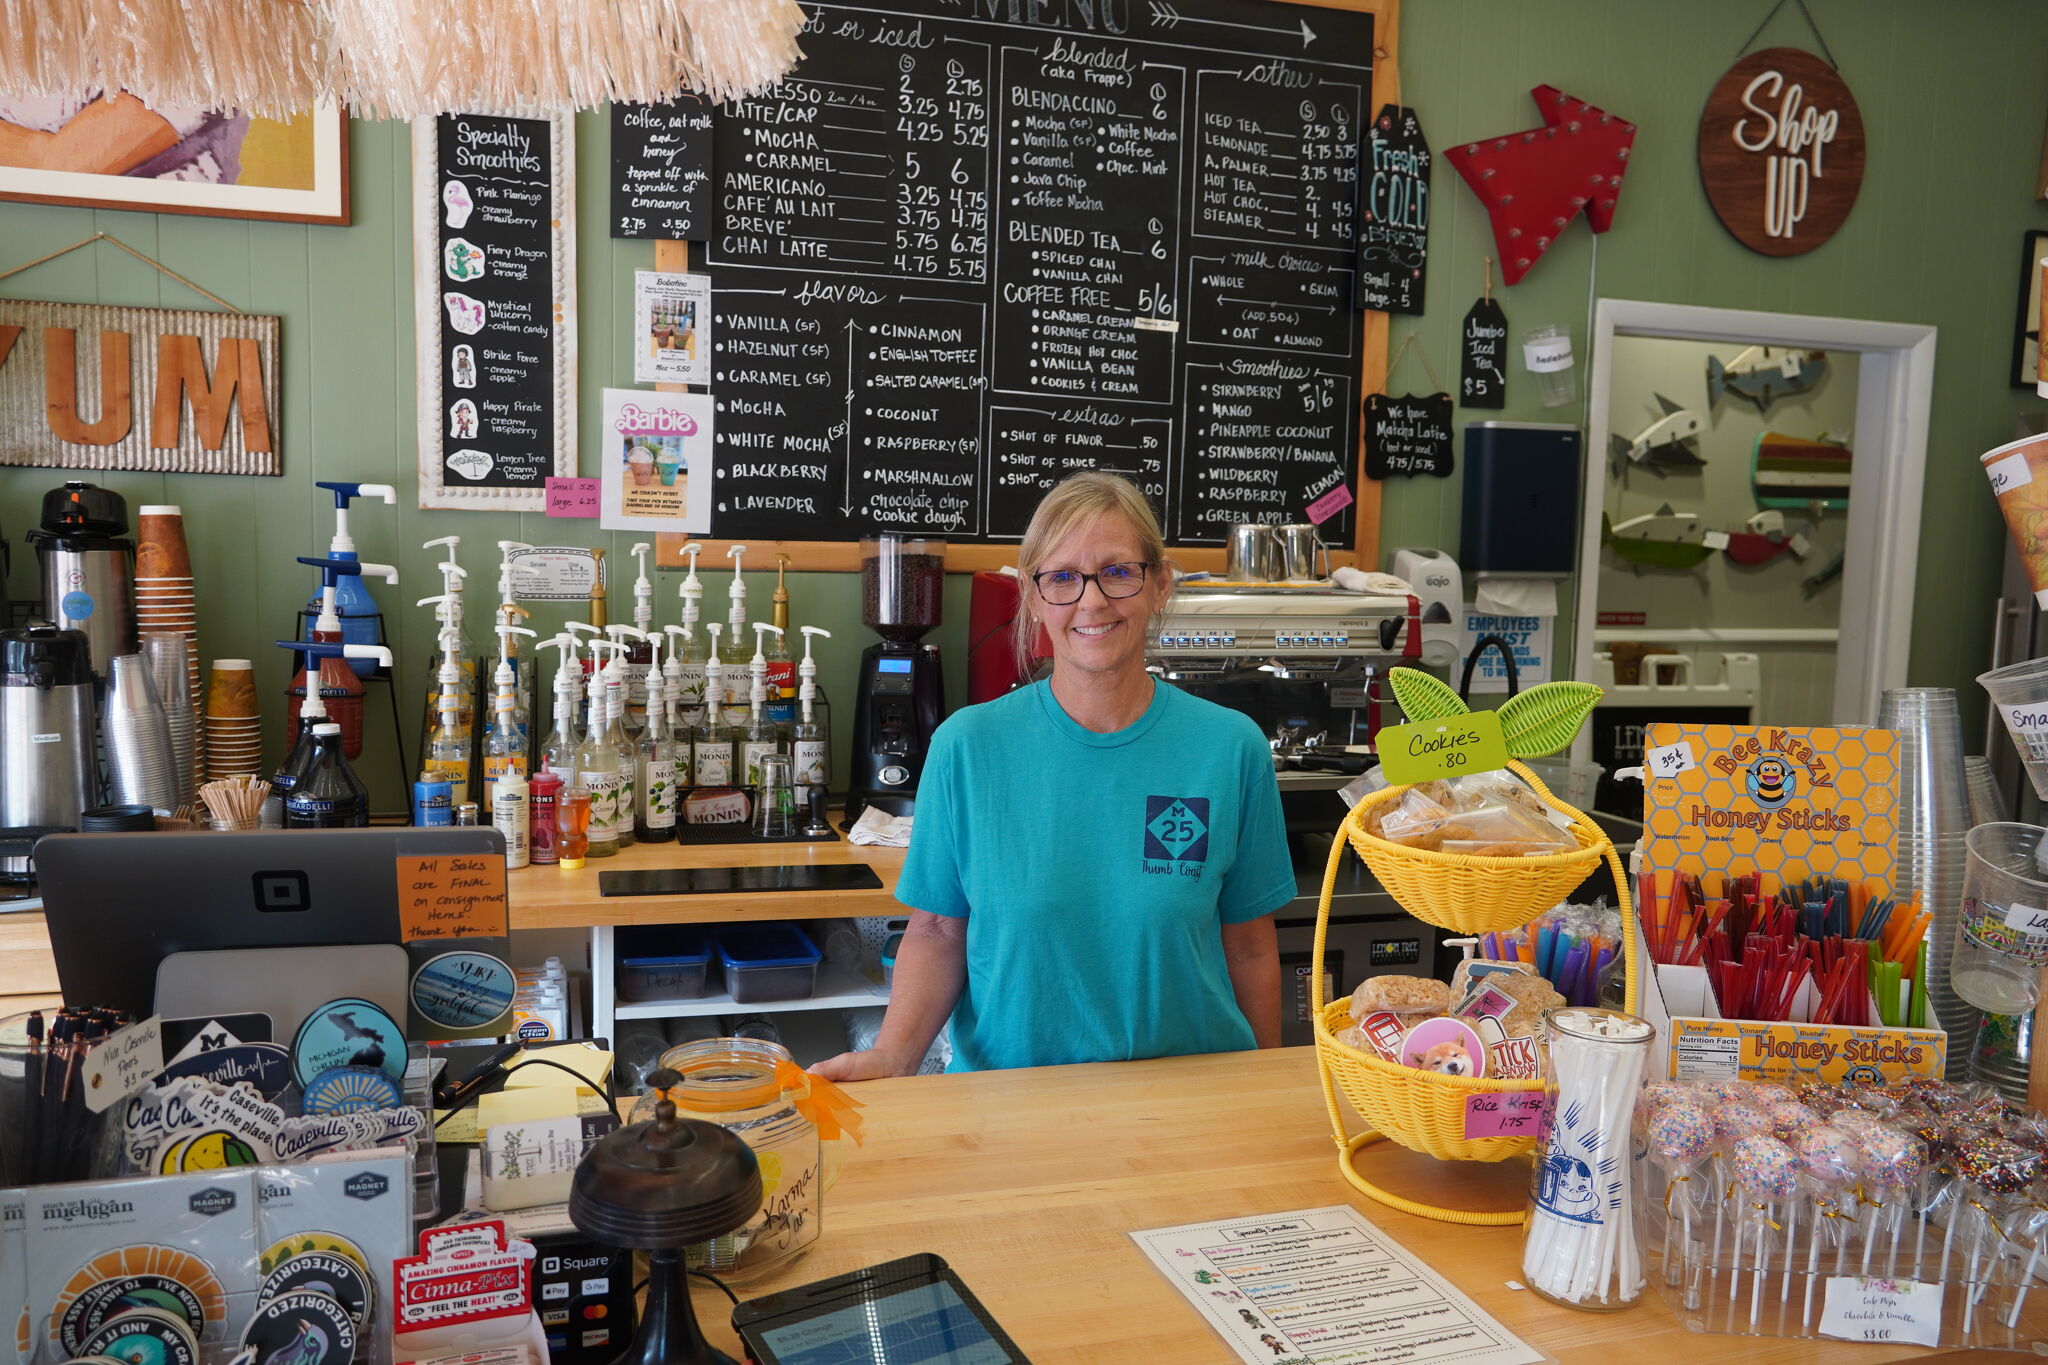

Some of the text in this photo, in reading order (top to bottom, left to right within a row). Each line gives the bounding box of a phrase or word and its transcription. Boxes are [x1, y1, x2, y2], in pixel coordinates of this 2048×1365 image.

[1043, 37, 1136, 72] blended
[947, 79, 983, 97] 2.75
[1012, 86, 1116, 115] BLENDACCINO
[1732, 70, 1839, 178] Shop
[457, 122, 530, 157] Specialty
[755, 130, 819, 150] MOCHA
[457, 147, 541, 173] Smoothies
[1372, 138, 1418, 176] Fresh
[724, 172, 987, 211] AMERICANO 3.25 4.75
[1204, 173, 1256, 193] HOT TEA
[476, 187, 542, 206] Pink Flamingo
[1370, 172, 1429, 228] COLD
[621, 217, 691, 230] 2.75 3.50
[1204, 208, 1264, 229] STEAMER
[896, 230, 987, 253] 5.75 6.75
[1009, 220, 1120, 251] BLENDED TEA
[1368, 226, 1426, 250] BREW
[515, 247, 547, 262] Dragon
[722, 235, 985, 278] CHAI LATTE 4.75 5.75
[1041, 251, 1116, 270] SPICED CHAI
[1209, 275, 1245, 288] WHOLE
[793, 280, 887, 305] flavors
[1004, 283, 1110, 308] COFFEE FREE
[488, 300, 532, 313] Mystical
[727, 314, 789, 333] VANILLA
[1233, 327, 1259, 339] OAT
[1466, 318, 1505, 339] Jumbo
[881, 324, 962, 343] CINNAMON
[483, 350, 539, 364] Strike Force
[728, 339, 798, 358] HAZELNUT
[880, 346, 978, 364] ENGLISH TOFFEE
[1470, 341, 1496, 356] Iced
[729, 369, 801, 387] CARAMEL
[875, 374, 916, 388] SALTED
[483, 400, 542, 415] Happy Pirate
[731, 398, 787, 417] MOCHA
[1387, 404, 1428, 420] We have
[616, 403, 698, 436] Barbie
[1210, 423, 1334, 439] PINEAPPLE COCONUT
[1377, 421, 1447, 440] Matcha Latte
[728, 432, 831, 453] WHITE MOCHA
[496, 453, 546, 464] Lemon Tree
[732, 463, 827, 482] BLACKBERRY
[874, 468, 974, 487] MARSHMALLOW
[1209, 468, 1278, 486] WILDBERRY
[735, 495, 816, 514] LAVENDER
[1209, 487, 1287, 506] RASPBERRY
[1206, 509, 1249, 523] GREEN
[1468, 616, 1539, 631] EMPLOYEES
[1409, 728, 1481, 758] Cookies
[700, 752, 731, 761] MONIN
[1712, 729, 1833, 789] Bee Krazy
[694, 809, 742, 824] MONIN
[1171, 806, 1185, 817] M
[1691, 805, 1851, 834] Honey Sticks
[1161, 820, 1194, 842] 25
[1655, 833, 1690, 841] Watermelon
[1762, 837, 1782, 845] Cherry
[450, 859, 486, 871] Sales
[1141, 860, 1173, 875] Thumb
[1686, 1024, 1723, 1034] Pure Honey
[1739, 1027, 1772, 1035] Cinnamon
[1799, 1030, 1831, 1039] Blueberry
[1856, 1032, 1892, 1041] Strawberry
[200, 1033, 227, 1051] M
[1680, 1036, 1739, 1046] Nutrition Facts
[1903, 1034, 1944, 1044] Green Apple
[1755, 1035, 1923, 1066] Honey Sticks
[1471, 1098, 1498, 1113] Rice
[220, 1108, 242, 1128] the
[275, 1119, 347, 1158] Caseville
[348, 1182, 386, 1192] MAGNET
[191, 1198, 233, 1208] MAGNET
[763, 1162, 818, 1232] Karma
[42, 1200, 134, 1220] michigan
[407, 1256, 518, 1280] AMAZING CINNAMON FLAVOR
[563, 1256, 609, 1270] Square
[410, 1271, 516, 1301] Cinna-Pix
[552, 1287, 566, 1296] Pay
[452, 1299, 468, 1309] THE
[548, 1312, 567, 1320] VISA
[120, 1322, 149, 1334] AND
